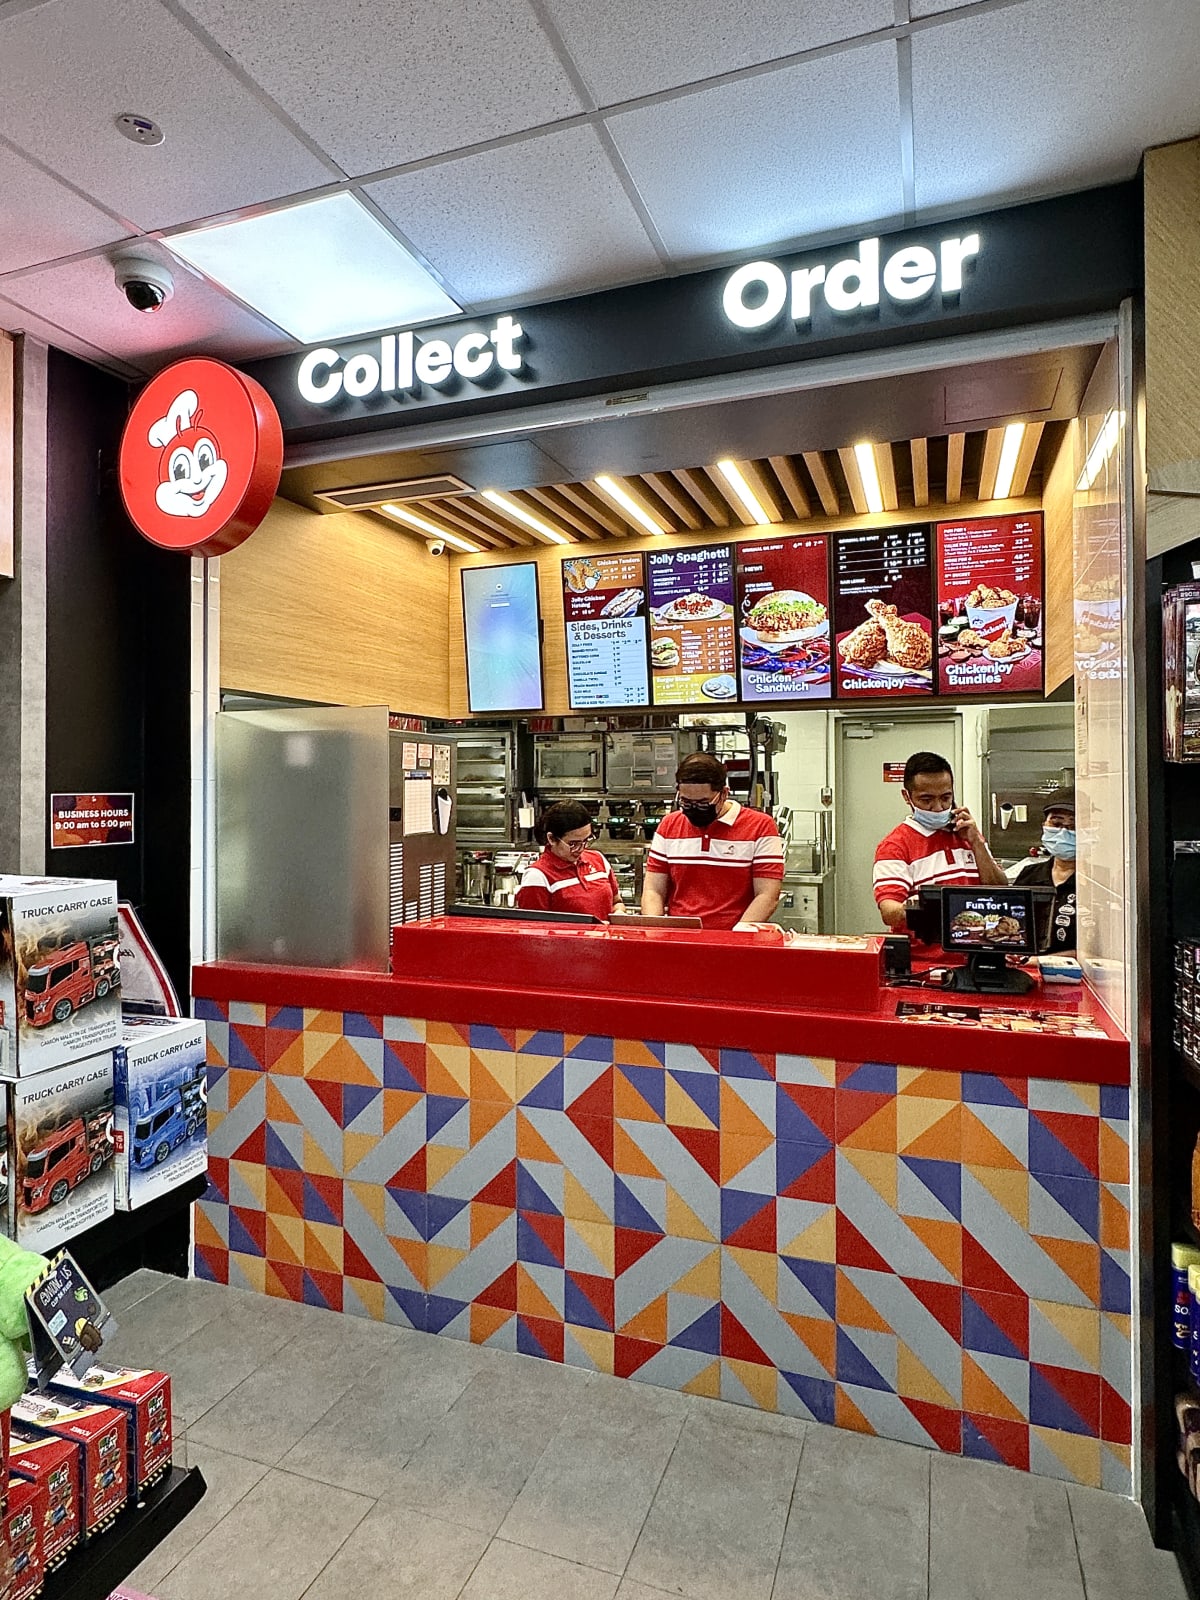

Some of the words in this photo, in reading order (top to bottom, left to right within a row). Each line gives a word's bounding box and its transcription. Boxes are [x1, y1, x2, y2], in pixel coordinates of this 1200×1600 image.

[721, 233, 980, 328] Order
[297, 314, 523, 405] Collect
[649, 554, 675, 566] Jolly
[676, 547, 730, 564] Spaghetti
[571, 622, 600, 632] Sides,
[601, 620, 632, 630] Drinks
[574, 632, 581, 640] &
[583, 630, 626, 640] Desserts
[945, 662, 1014, 678] Chickenjoy
[748, 674, 792, 685] Chicken
[842, 677, 905, 690] Chickenjoy
[949, 674, 1002, 685] Bundles
[755, 681, 809, 693] Sandwich
[58, 810, 100, 819] BUSINESS
[100, 809, 129, 817] HOURS
[55, 821, 75, 830] 9:00
[119, 820, 132, 829] pm
[21, 905, 55, 919] TRUCK
[56, 901, 88, 913] CARRY
[90, 896, 113, 907] CASE
[965, 901, 985, 909] Fun
[986, 902, 1002, 910] for
[1002, 902, 1008, 910] 1
[132, 1053, 159, 1068] TRUCK
[160, 1044, 183, 1059] CARRY
[184, 1037, 203, 1050] CASE
[22, 1087, 54, 1105] TRUCK
[56, 1077, 85, 1094] CARRY
[86, 1068, 109, 1082] CASE
[39, 1275, 63, 1306] AMONG
[60, 1264, 73, 1280] US
